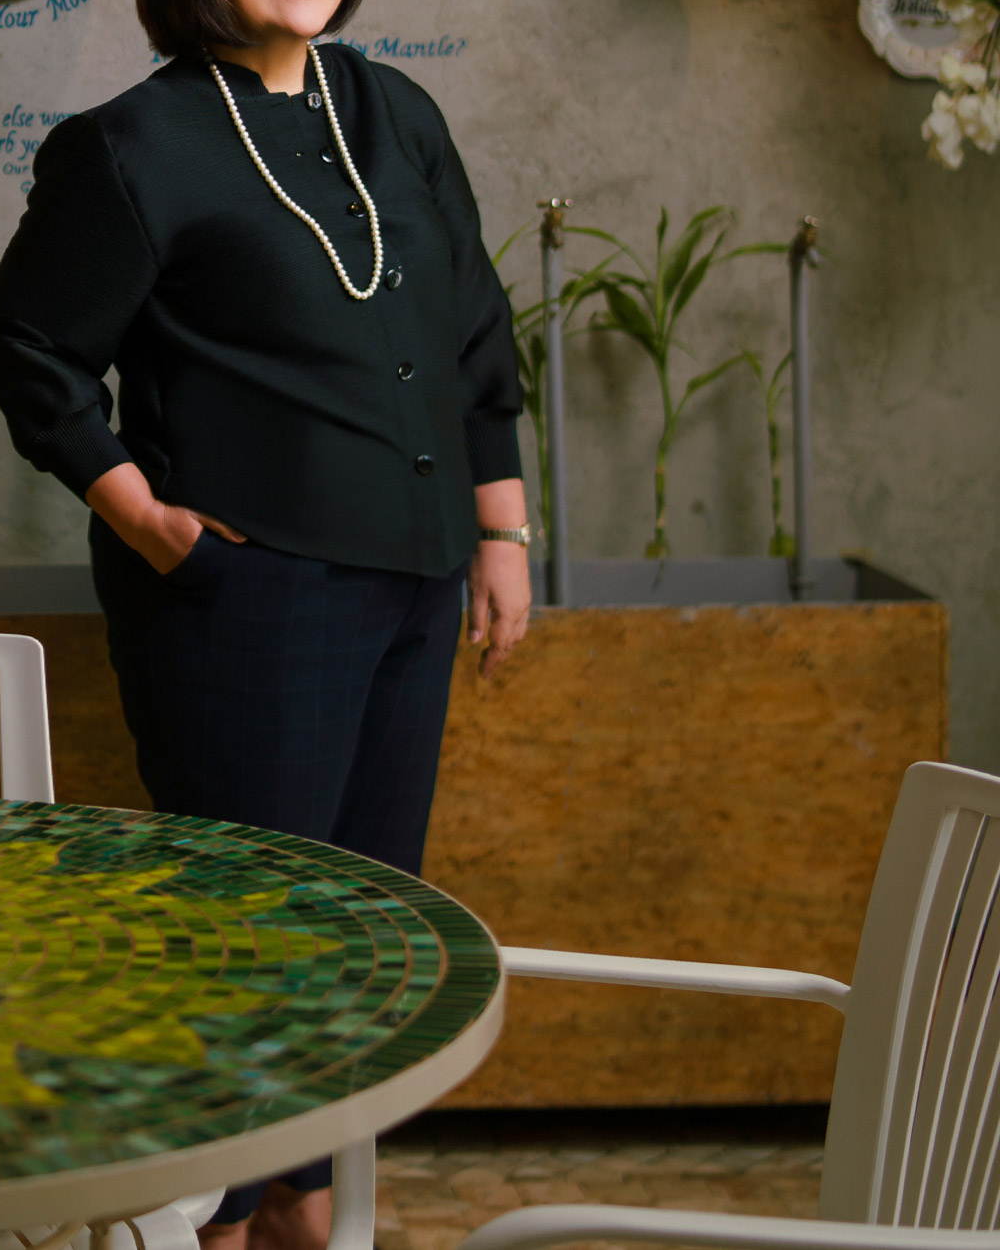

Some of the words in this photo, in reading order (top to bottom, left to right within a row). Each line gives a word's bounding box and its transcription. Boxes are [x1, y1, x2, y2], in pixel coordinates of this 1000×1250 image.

[374, 35, 467, 58] Mantle?
[2, 104, 32, 128] else
[17, 139, 40, 161] yo
